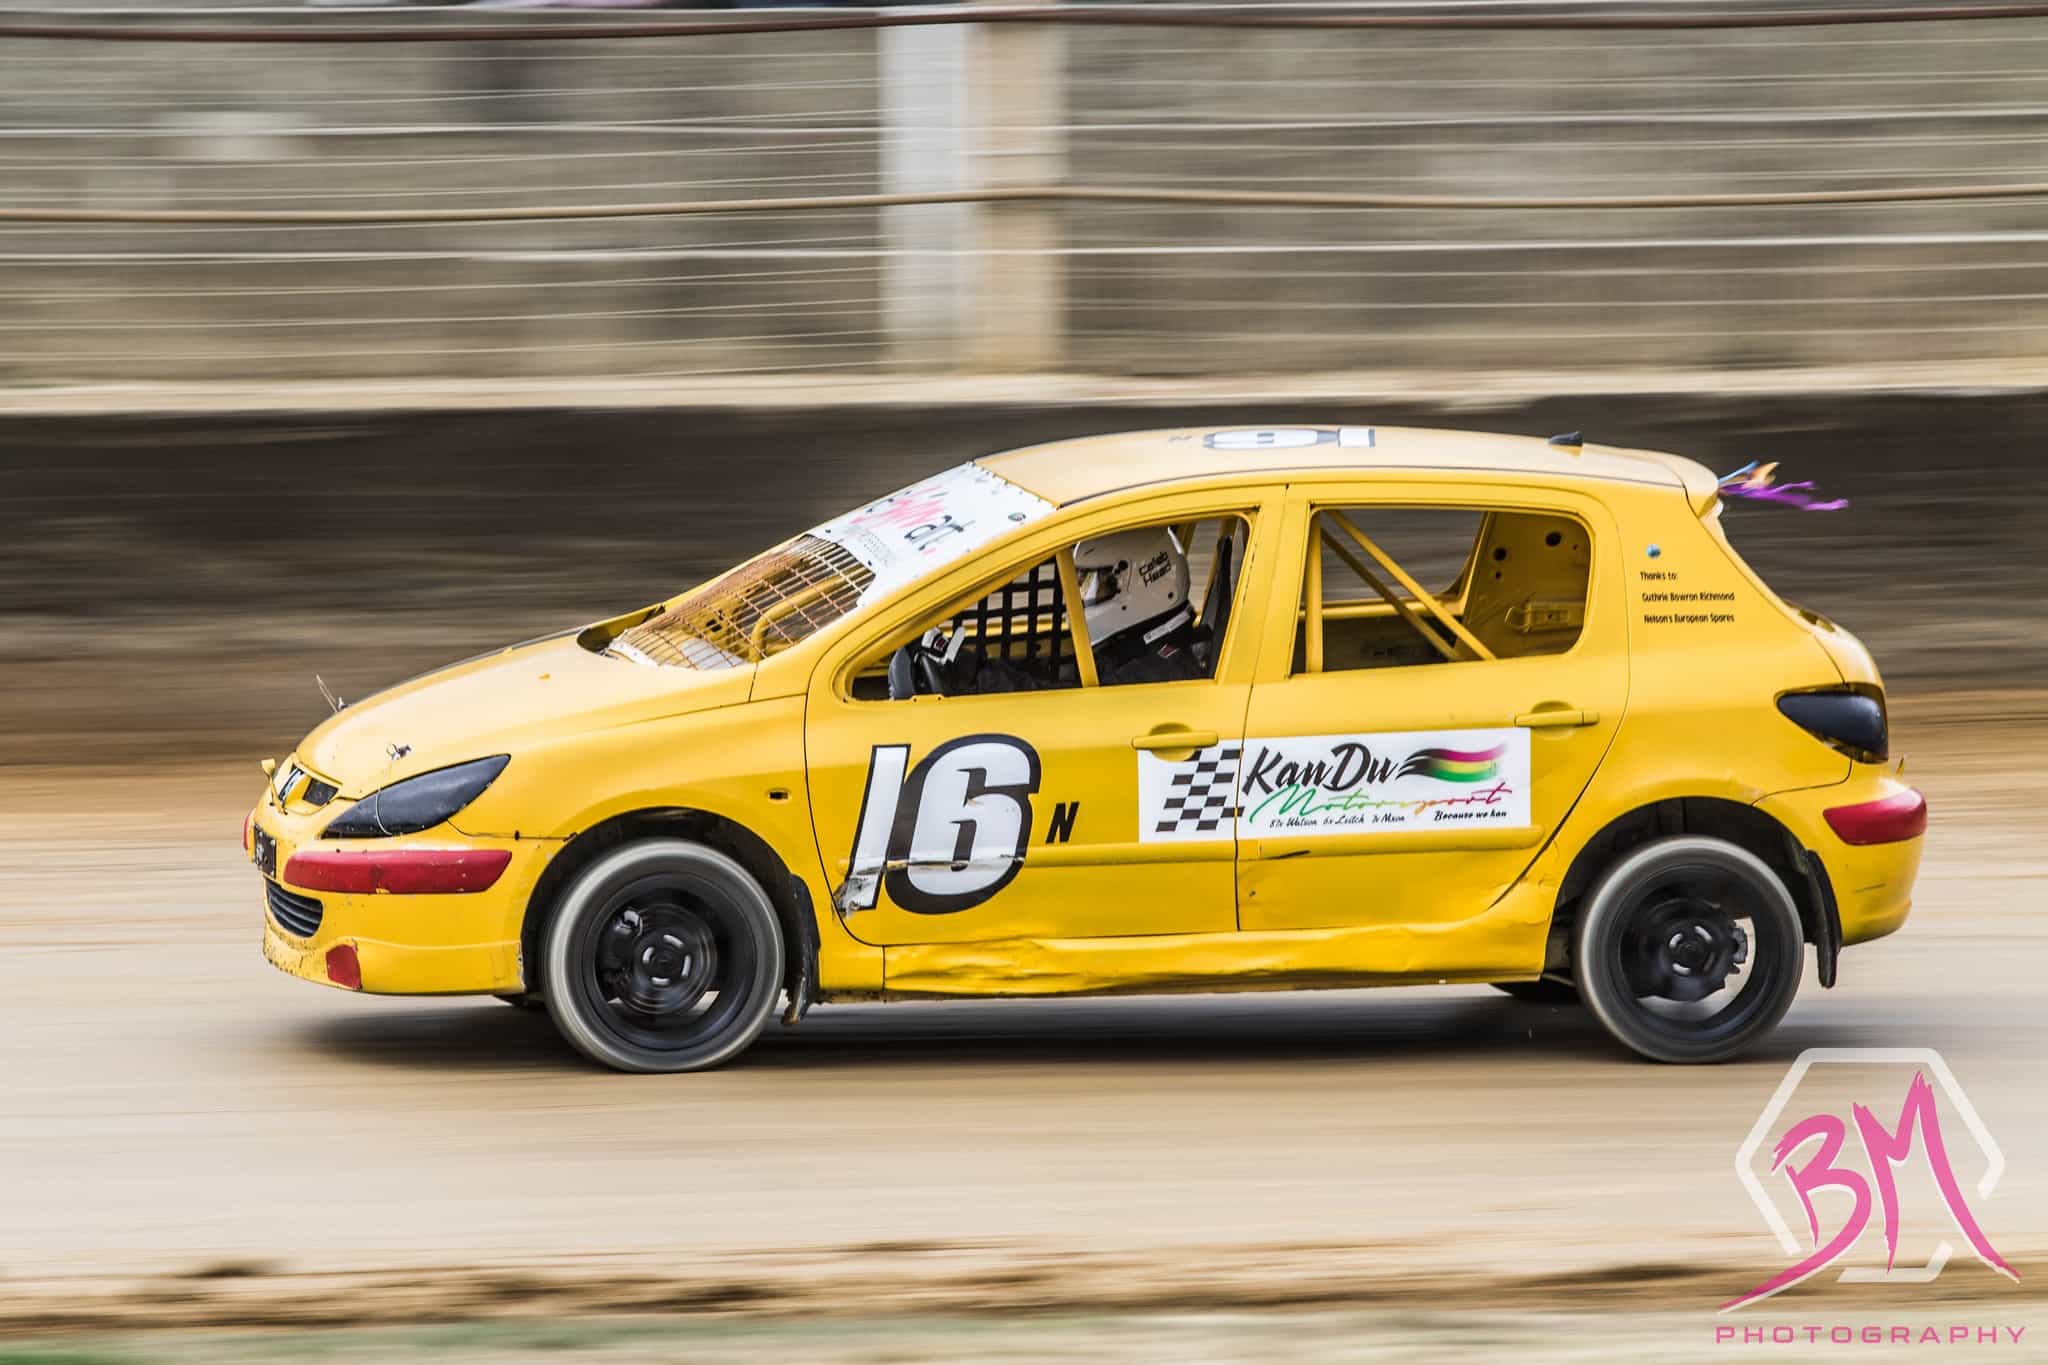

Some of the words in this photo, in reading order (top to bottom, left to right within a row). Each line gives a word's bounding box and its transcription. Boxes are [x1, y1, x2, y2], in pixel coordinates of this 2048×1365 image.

[1640, 571, 1666, 581] Thanks
[1642, 592, 1668, 602] Guthrie
[1699, 592, 1735, 602] Richmond
[1674, 614, 1708, 625] European
[1710, 614, 1735, 624] Spares
[1241, 741, 1399, 797] KanDu
[1248, 780, 1513, 824] Motorsport
[1434, 810, 1474, 822] Because
[1476, 811, 1488, 819] we
[833, 732, 1042, 916] 16
[1045, 802, 1080, 844] N
